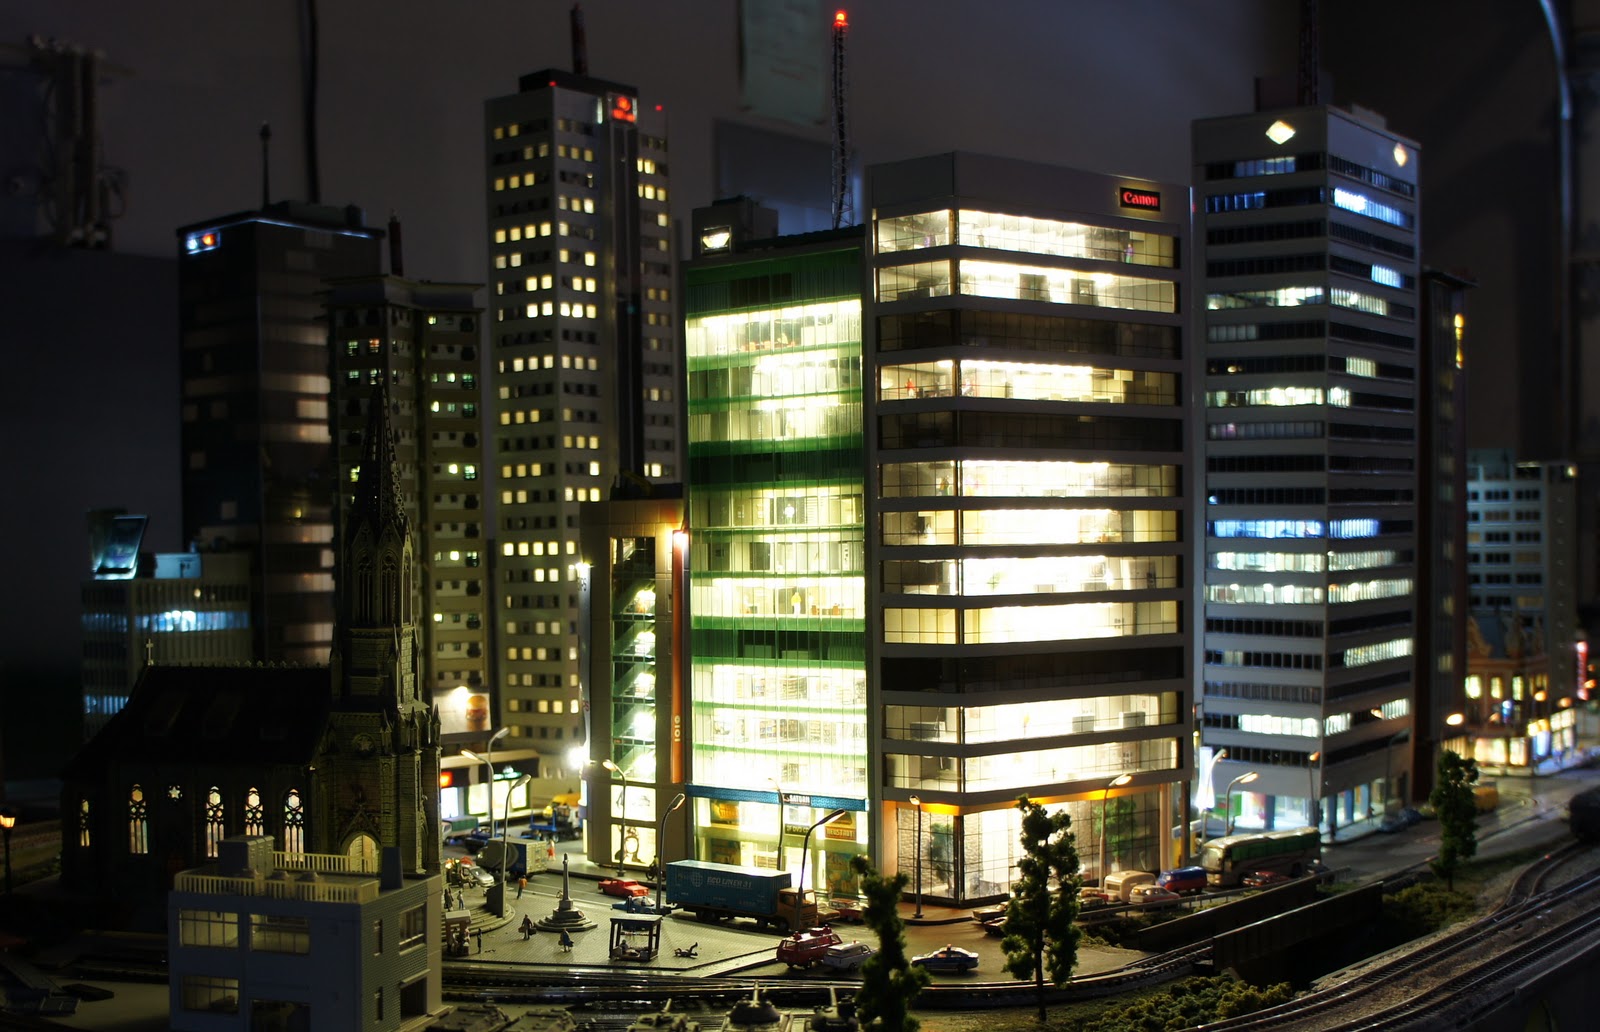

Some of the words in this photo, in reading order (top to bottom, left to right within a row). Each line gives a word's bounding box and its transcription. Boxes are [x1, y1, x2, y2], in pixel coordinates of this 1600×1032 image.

[1123, 191, 1158, 206] Canon
[707, 876, 721, 884] ECO
[722, 878, 742, 887] LINER
